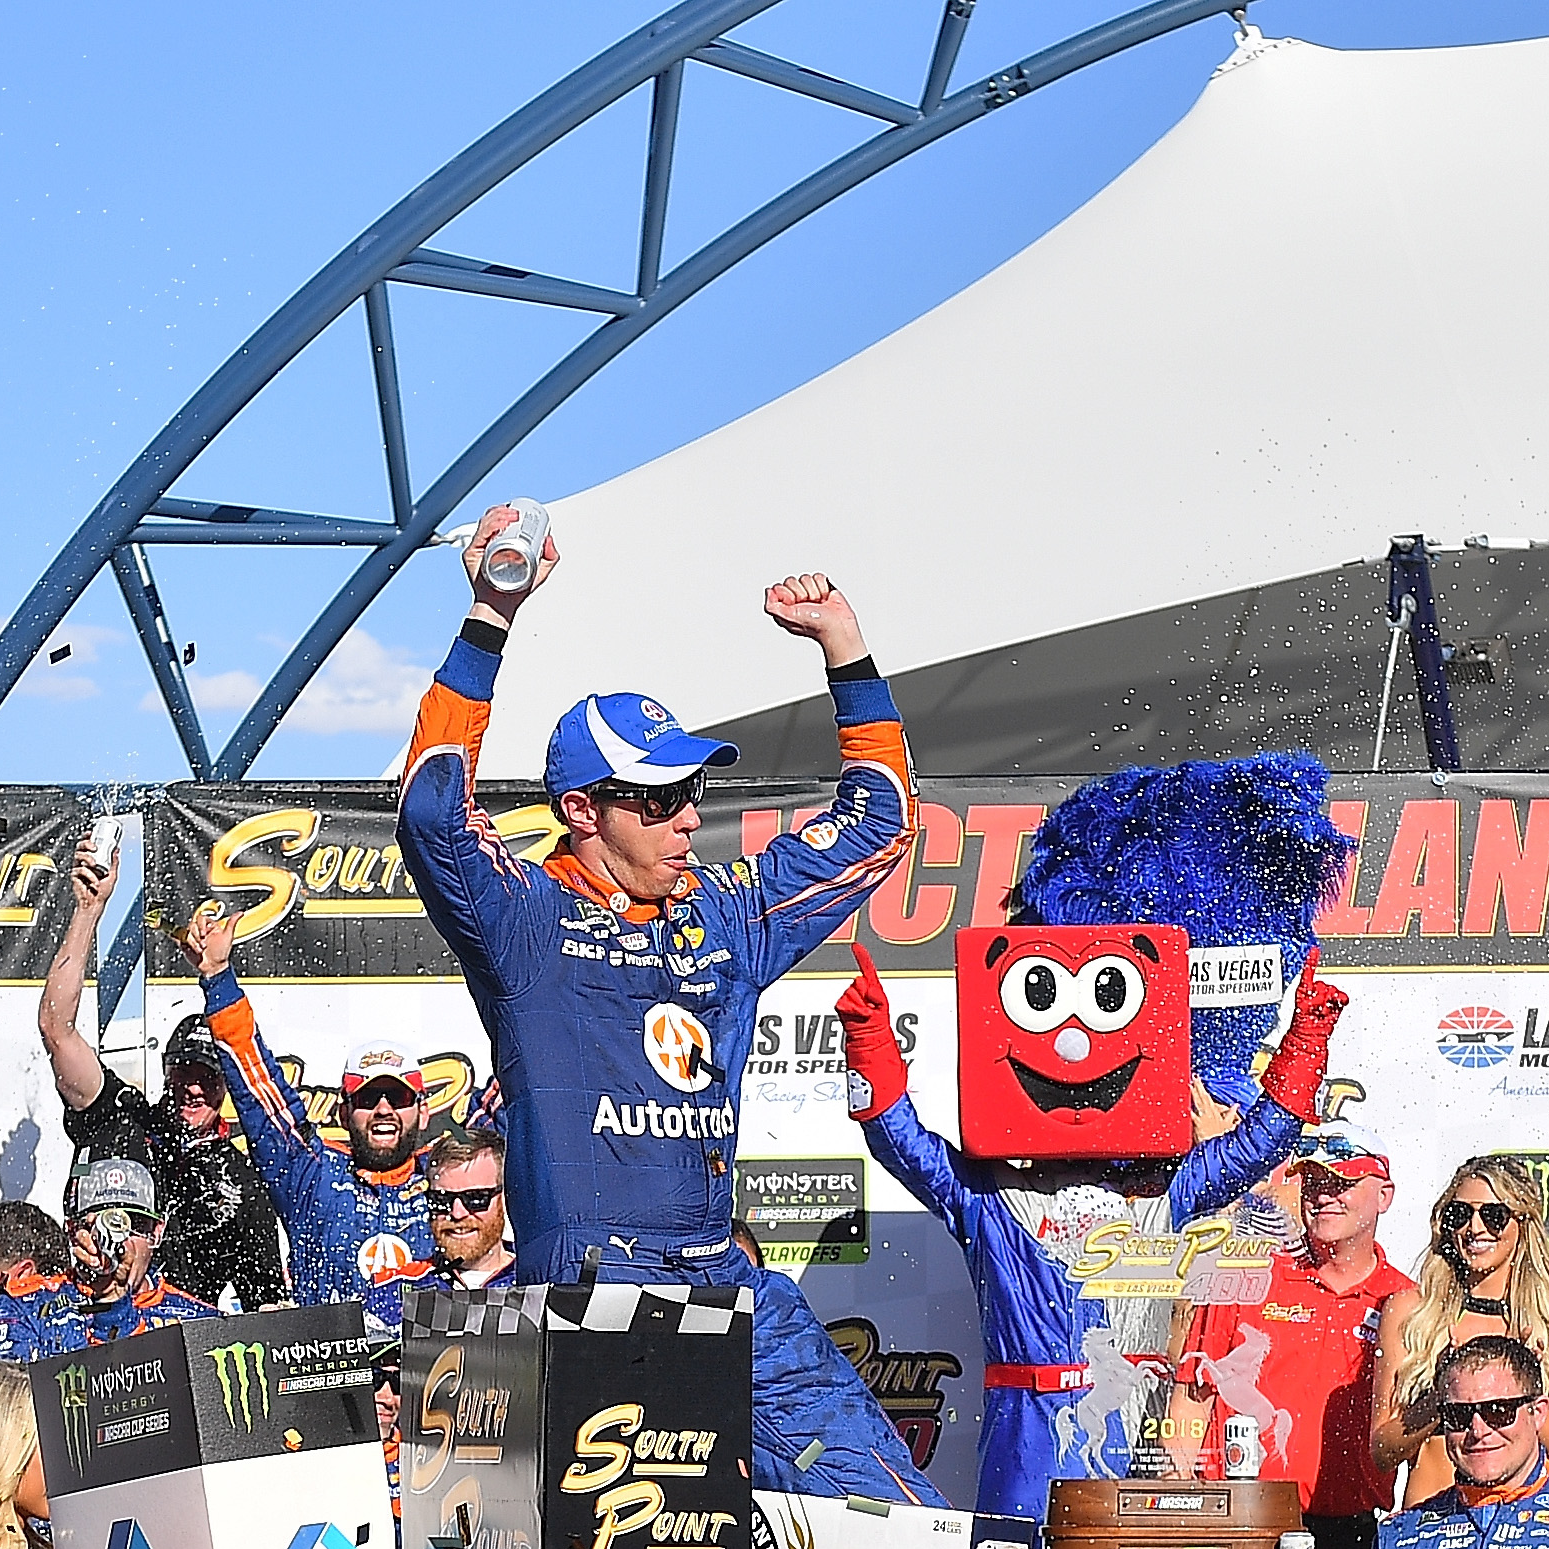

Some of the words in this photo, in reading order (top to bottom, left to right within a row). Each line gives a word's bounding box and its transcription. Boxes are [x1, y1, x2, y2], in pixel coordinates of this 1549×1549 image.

[1217, 958, 1273, 981] VEGAS
[745, 1171, 858, 1193] MONSTER
[762, 1195, 840, 1204] ENERGY
[760, 1207, 799, 1220] NASCAR
[801, 1207, 819, 1220] CUP
[271, 1338, 370, 1365] MONSTER
[289, 1358, 359, 1374] ENERGY
[91, 1358, 166, 1399] MONSTER
[290, 1376, 325, 1391] NASCAR
[326, 1374, 343, 1388] CUP
[104, 1394, 157, 1416] ENERGY
[1144, 1418, 1206, 1439] 2018
[560, 1403, 717, 1493] SOUTH
